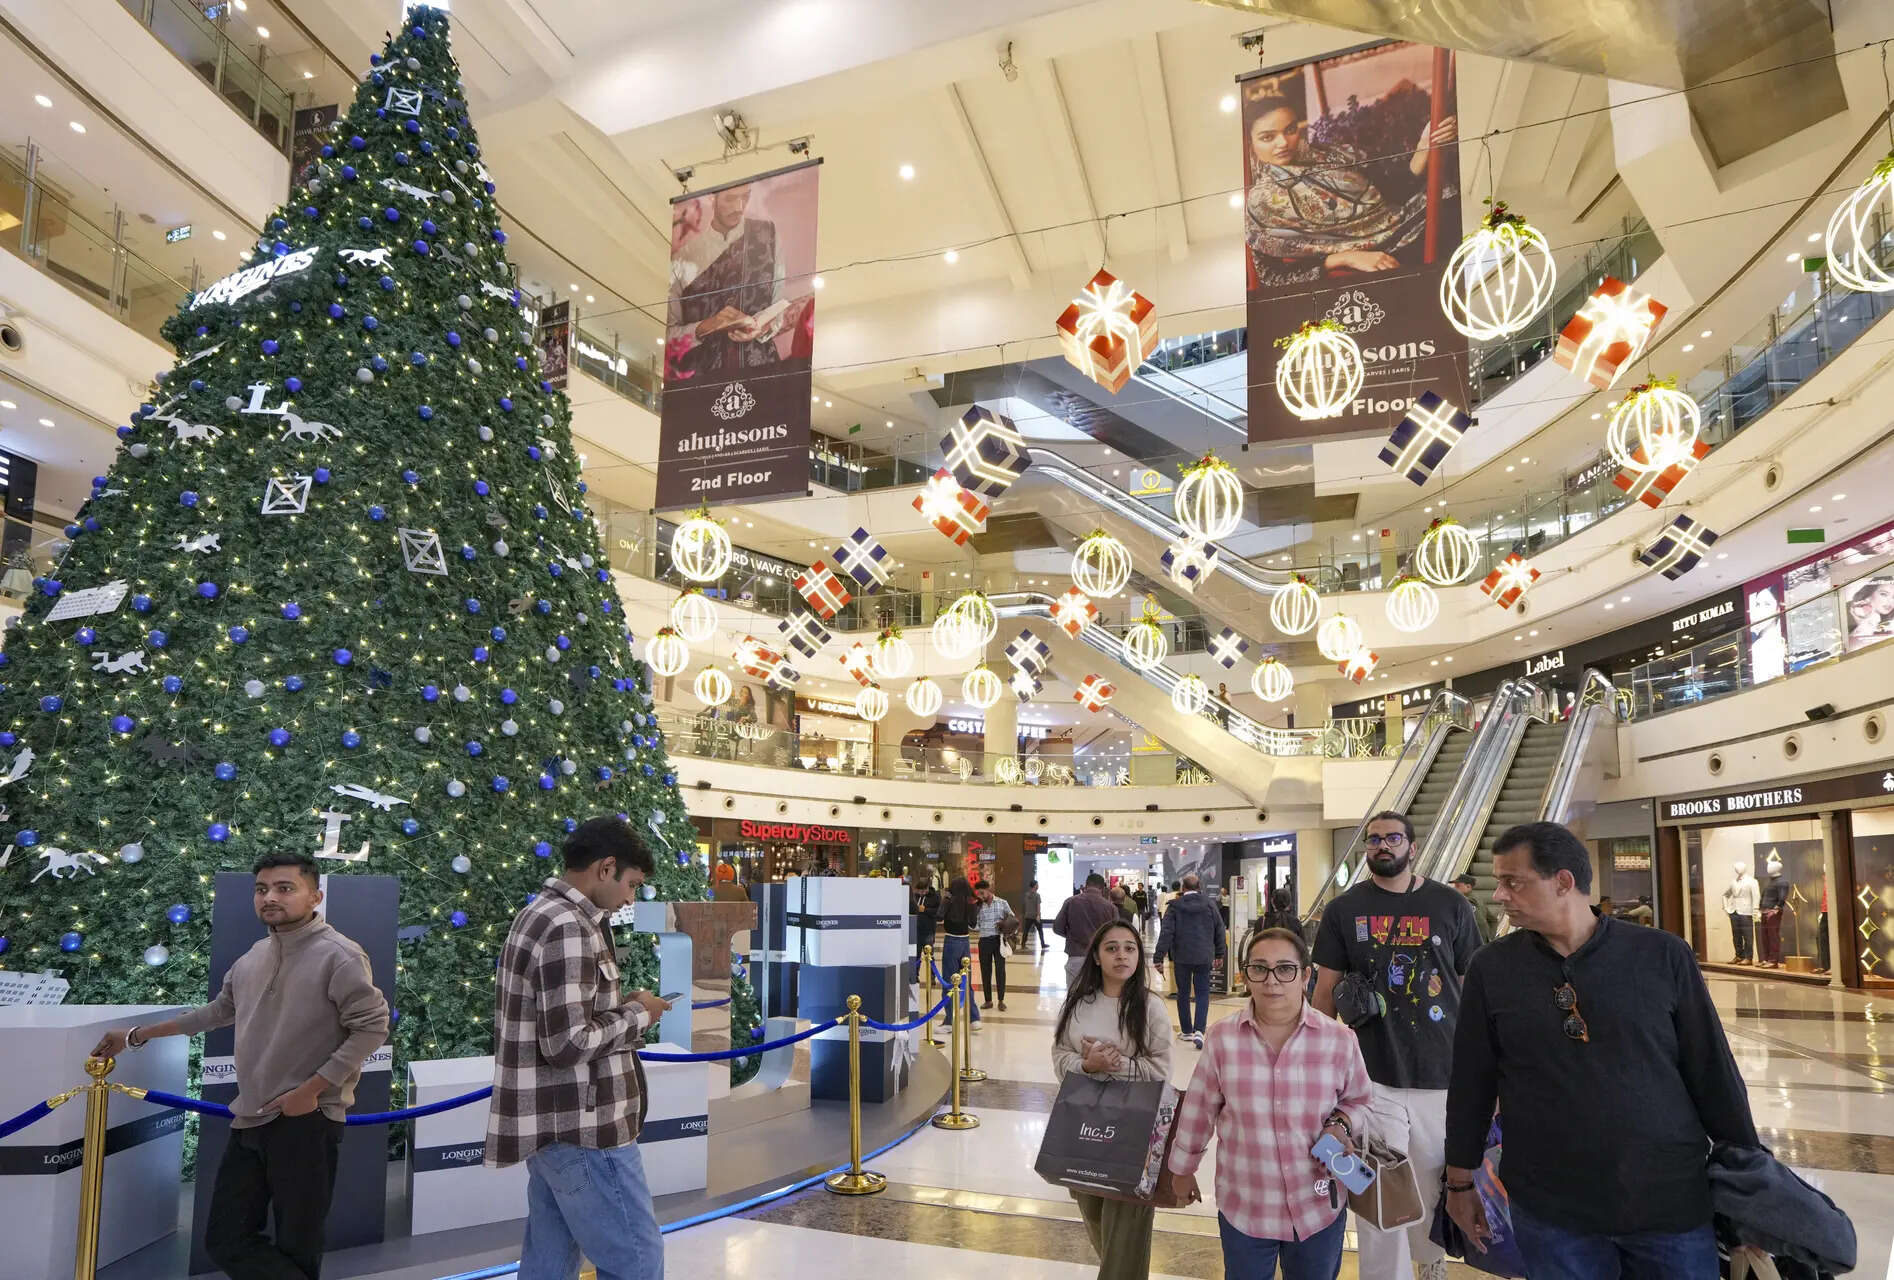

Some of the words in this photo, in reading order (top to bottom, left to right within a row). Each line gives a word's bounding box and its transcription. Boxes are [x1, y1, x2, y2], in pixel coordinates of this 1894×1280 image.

[677, 423, 788, 452] ahujasons
[691, 475, 721, 491] 2nd
[727, 471, 772, 486] Floor
[1672, 613, 1698, 632] RITU
[1699, 601, 1735, 623] KUMAR
[1526, 650, 1565, 677] Label
[948, 719, 984, 733] COST
[1670, 798, 1720, 816] BROOKS
[1727, 788, 1803, 811] BROTHERS
[681, 1120, 708, 1130] LONGI
[1080, 1122, 1115, 1139] Inc.5
[44, 1148, 83, 1165] LONGIN
[442, 1147, 486, 1160] LONGIN
